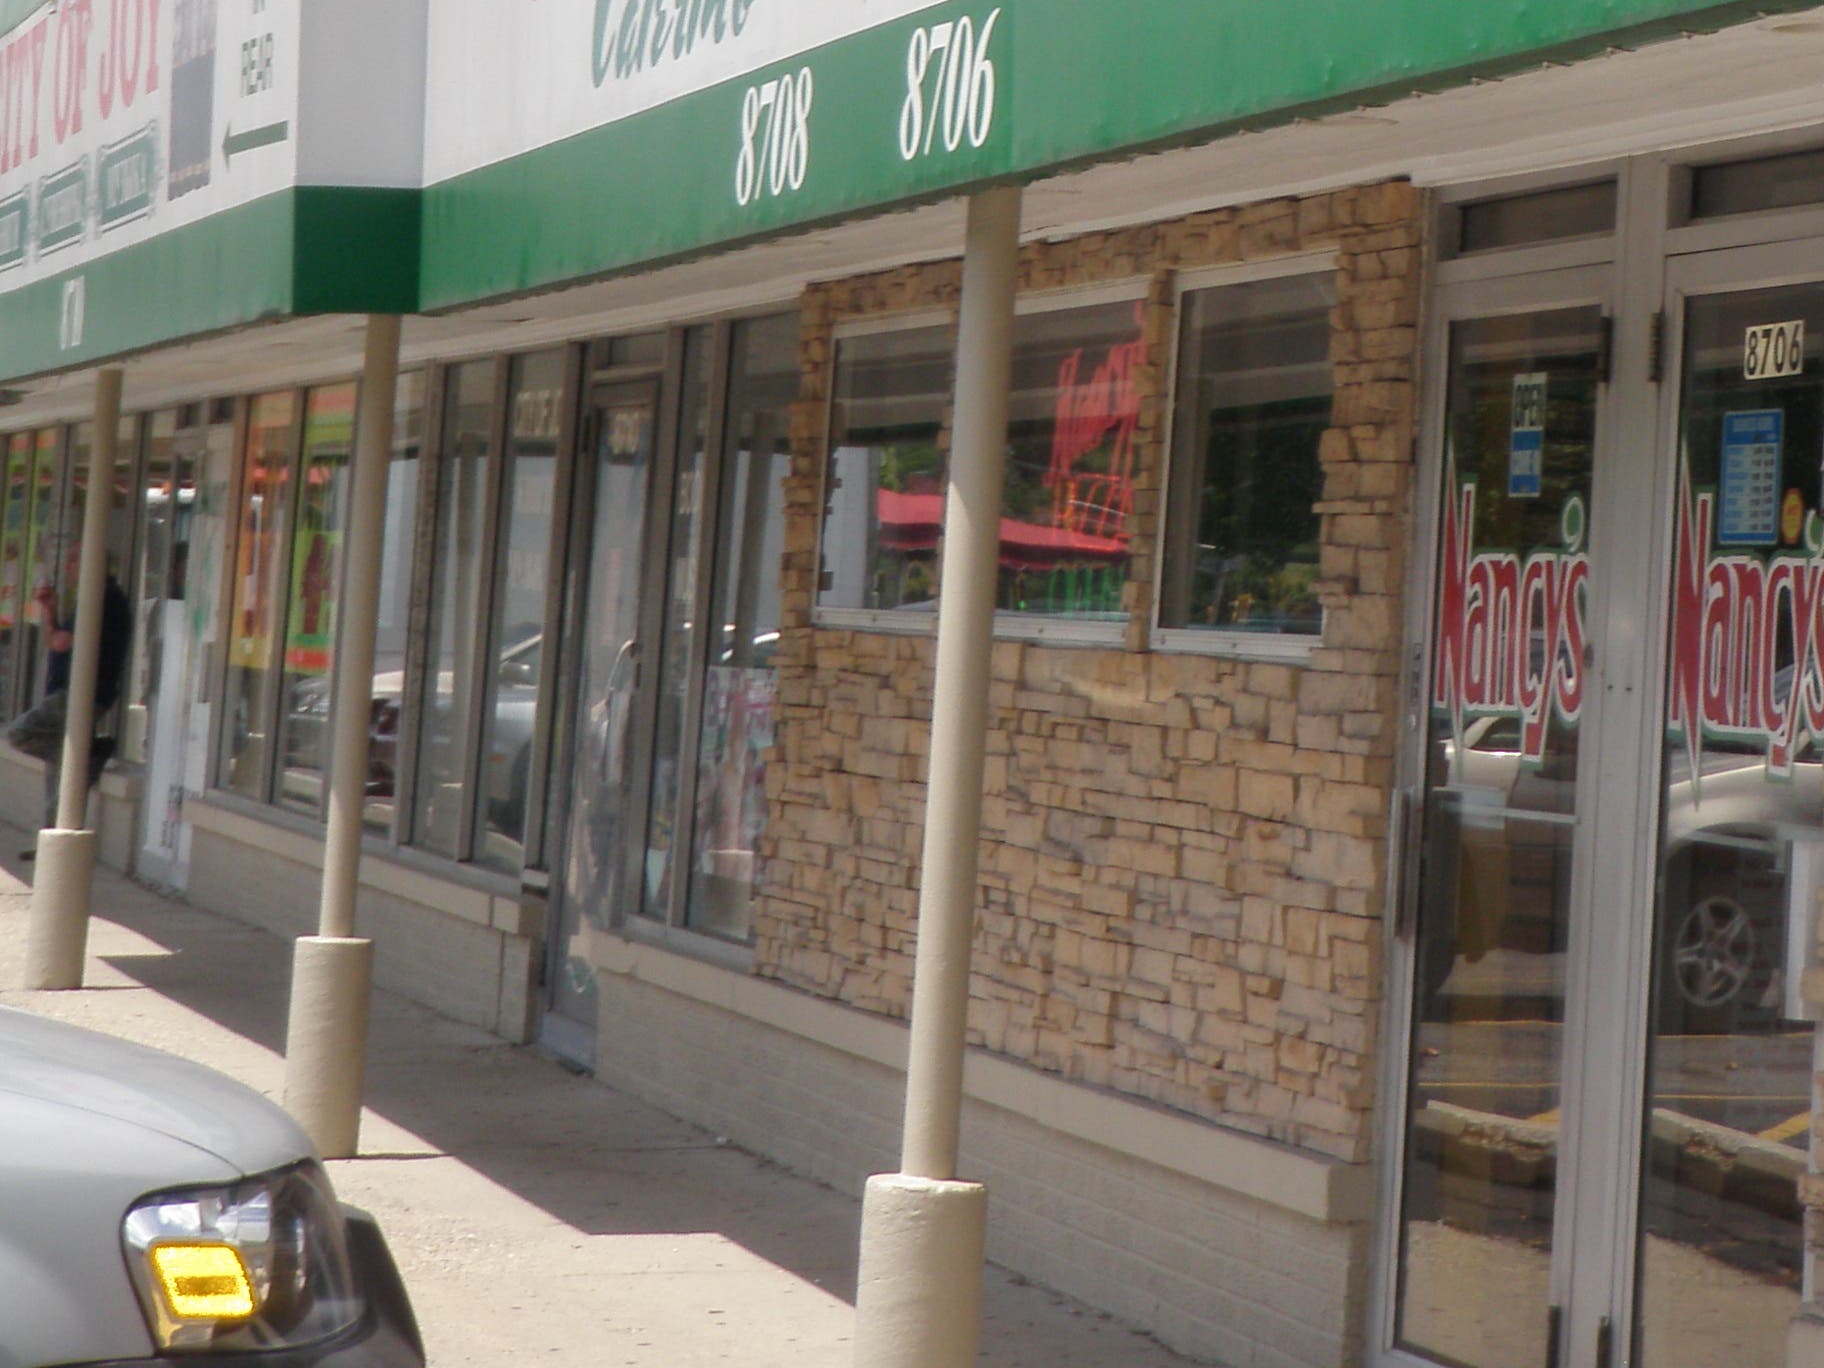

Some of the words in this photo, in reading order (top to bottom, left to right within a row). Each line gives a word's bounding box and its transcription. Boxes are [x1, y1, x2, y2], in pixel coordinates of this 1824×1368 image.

[240, 32, 273, 98] REAR
[900, 7, 1000, 160] 8706
[735, 66, 812, 206] 8708
[1747, 324, 1800, 376] 8706
